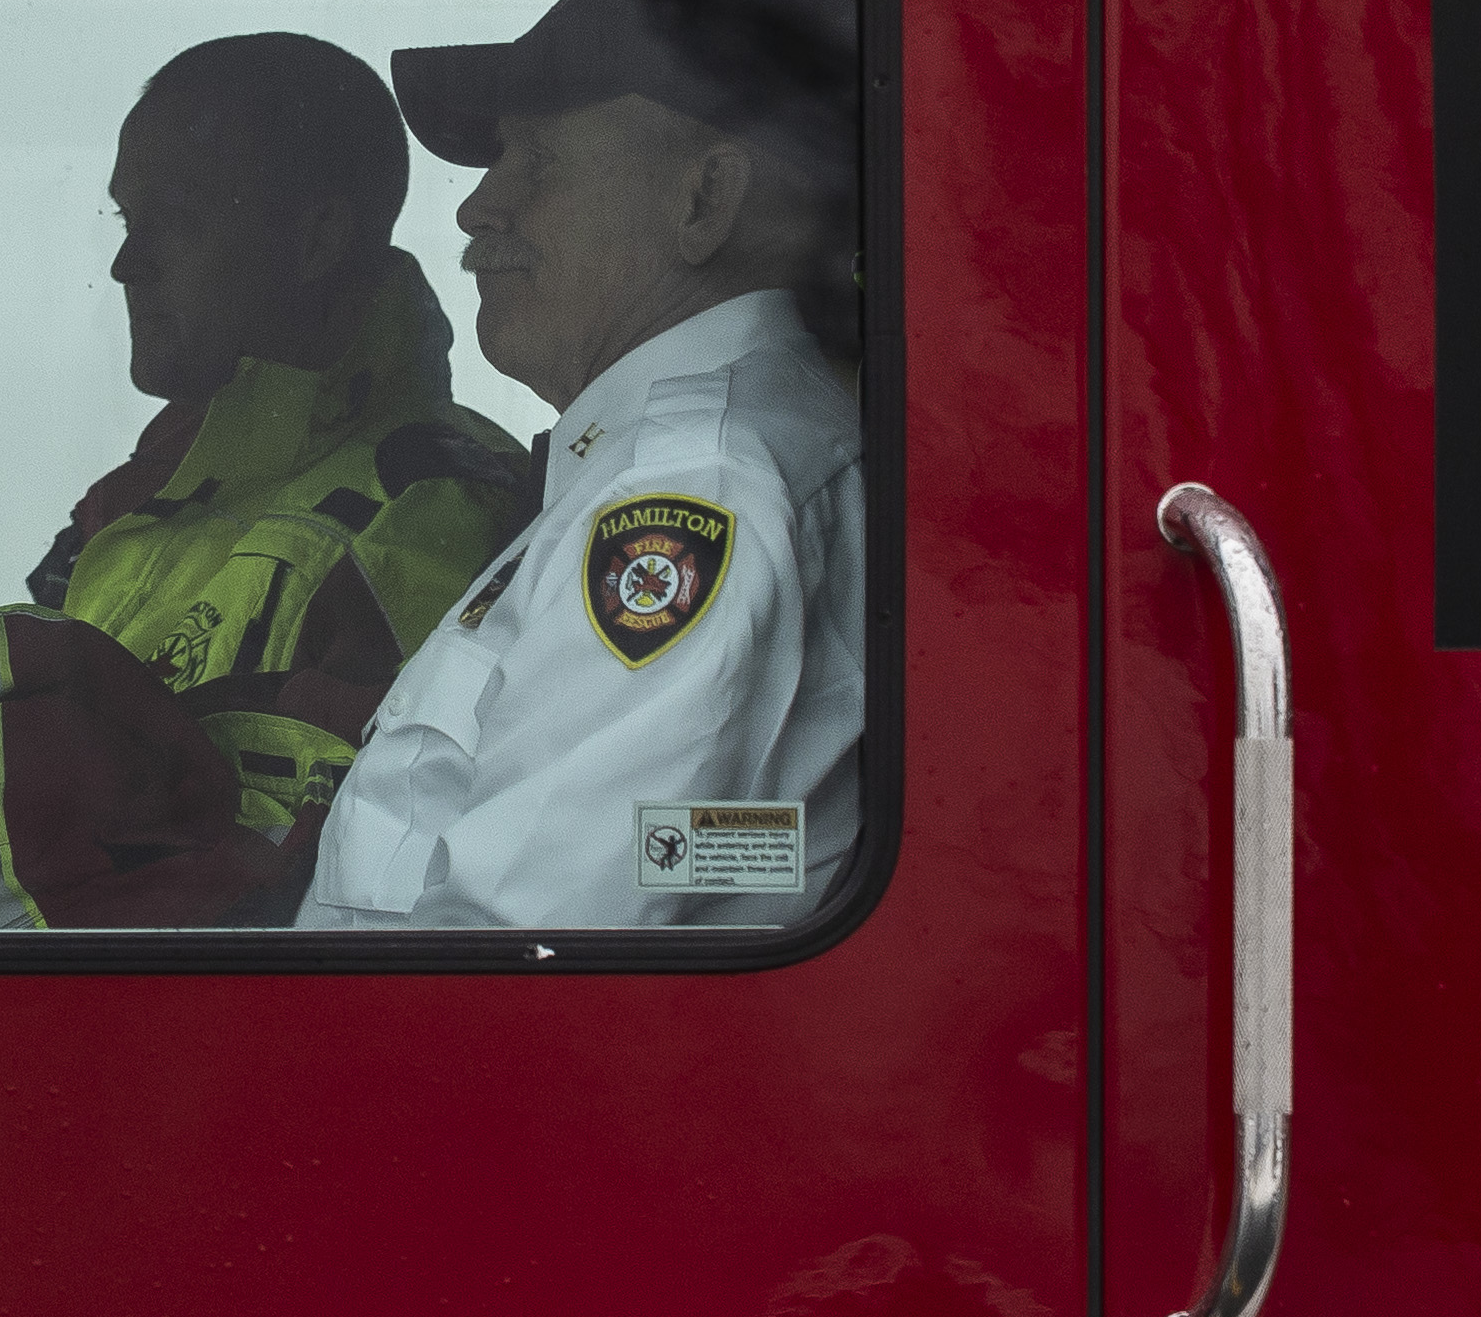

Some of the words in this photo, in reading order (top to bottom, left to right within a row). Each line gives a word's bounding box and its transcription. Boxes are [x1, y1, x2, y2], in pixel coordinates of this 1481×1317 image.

[600, 507, 725, 541] HAMILTON
[633, 538, 674, 556] FIRE
[717, 812, 791, 826] WARNING
